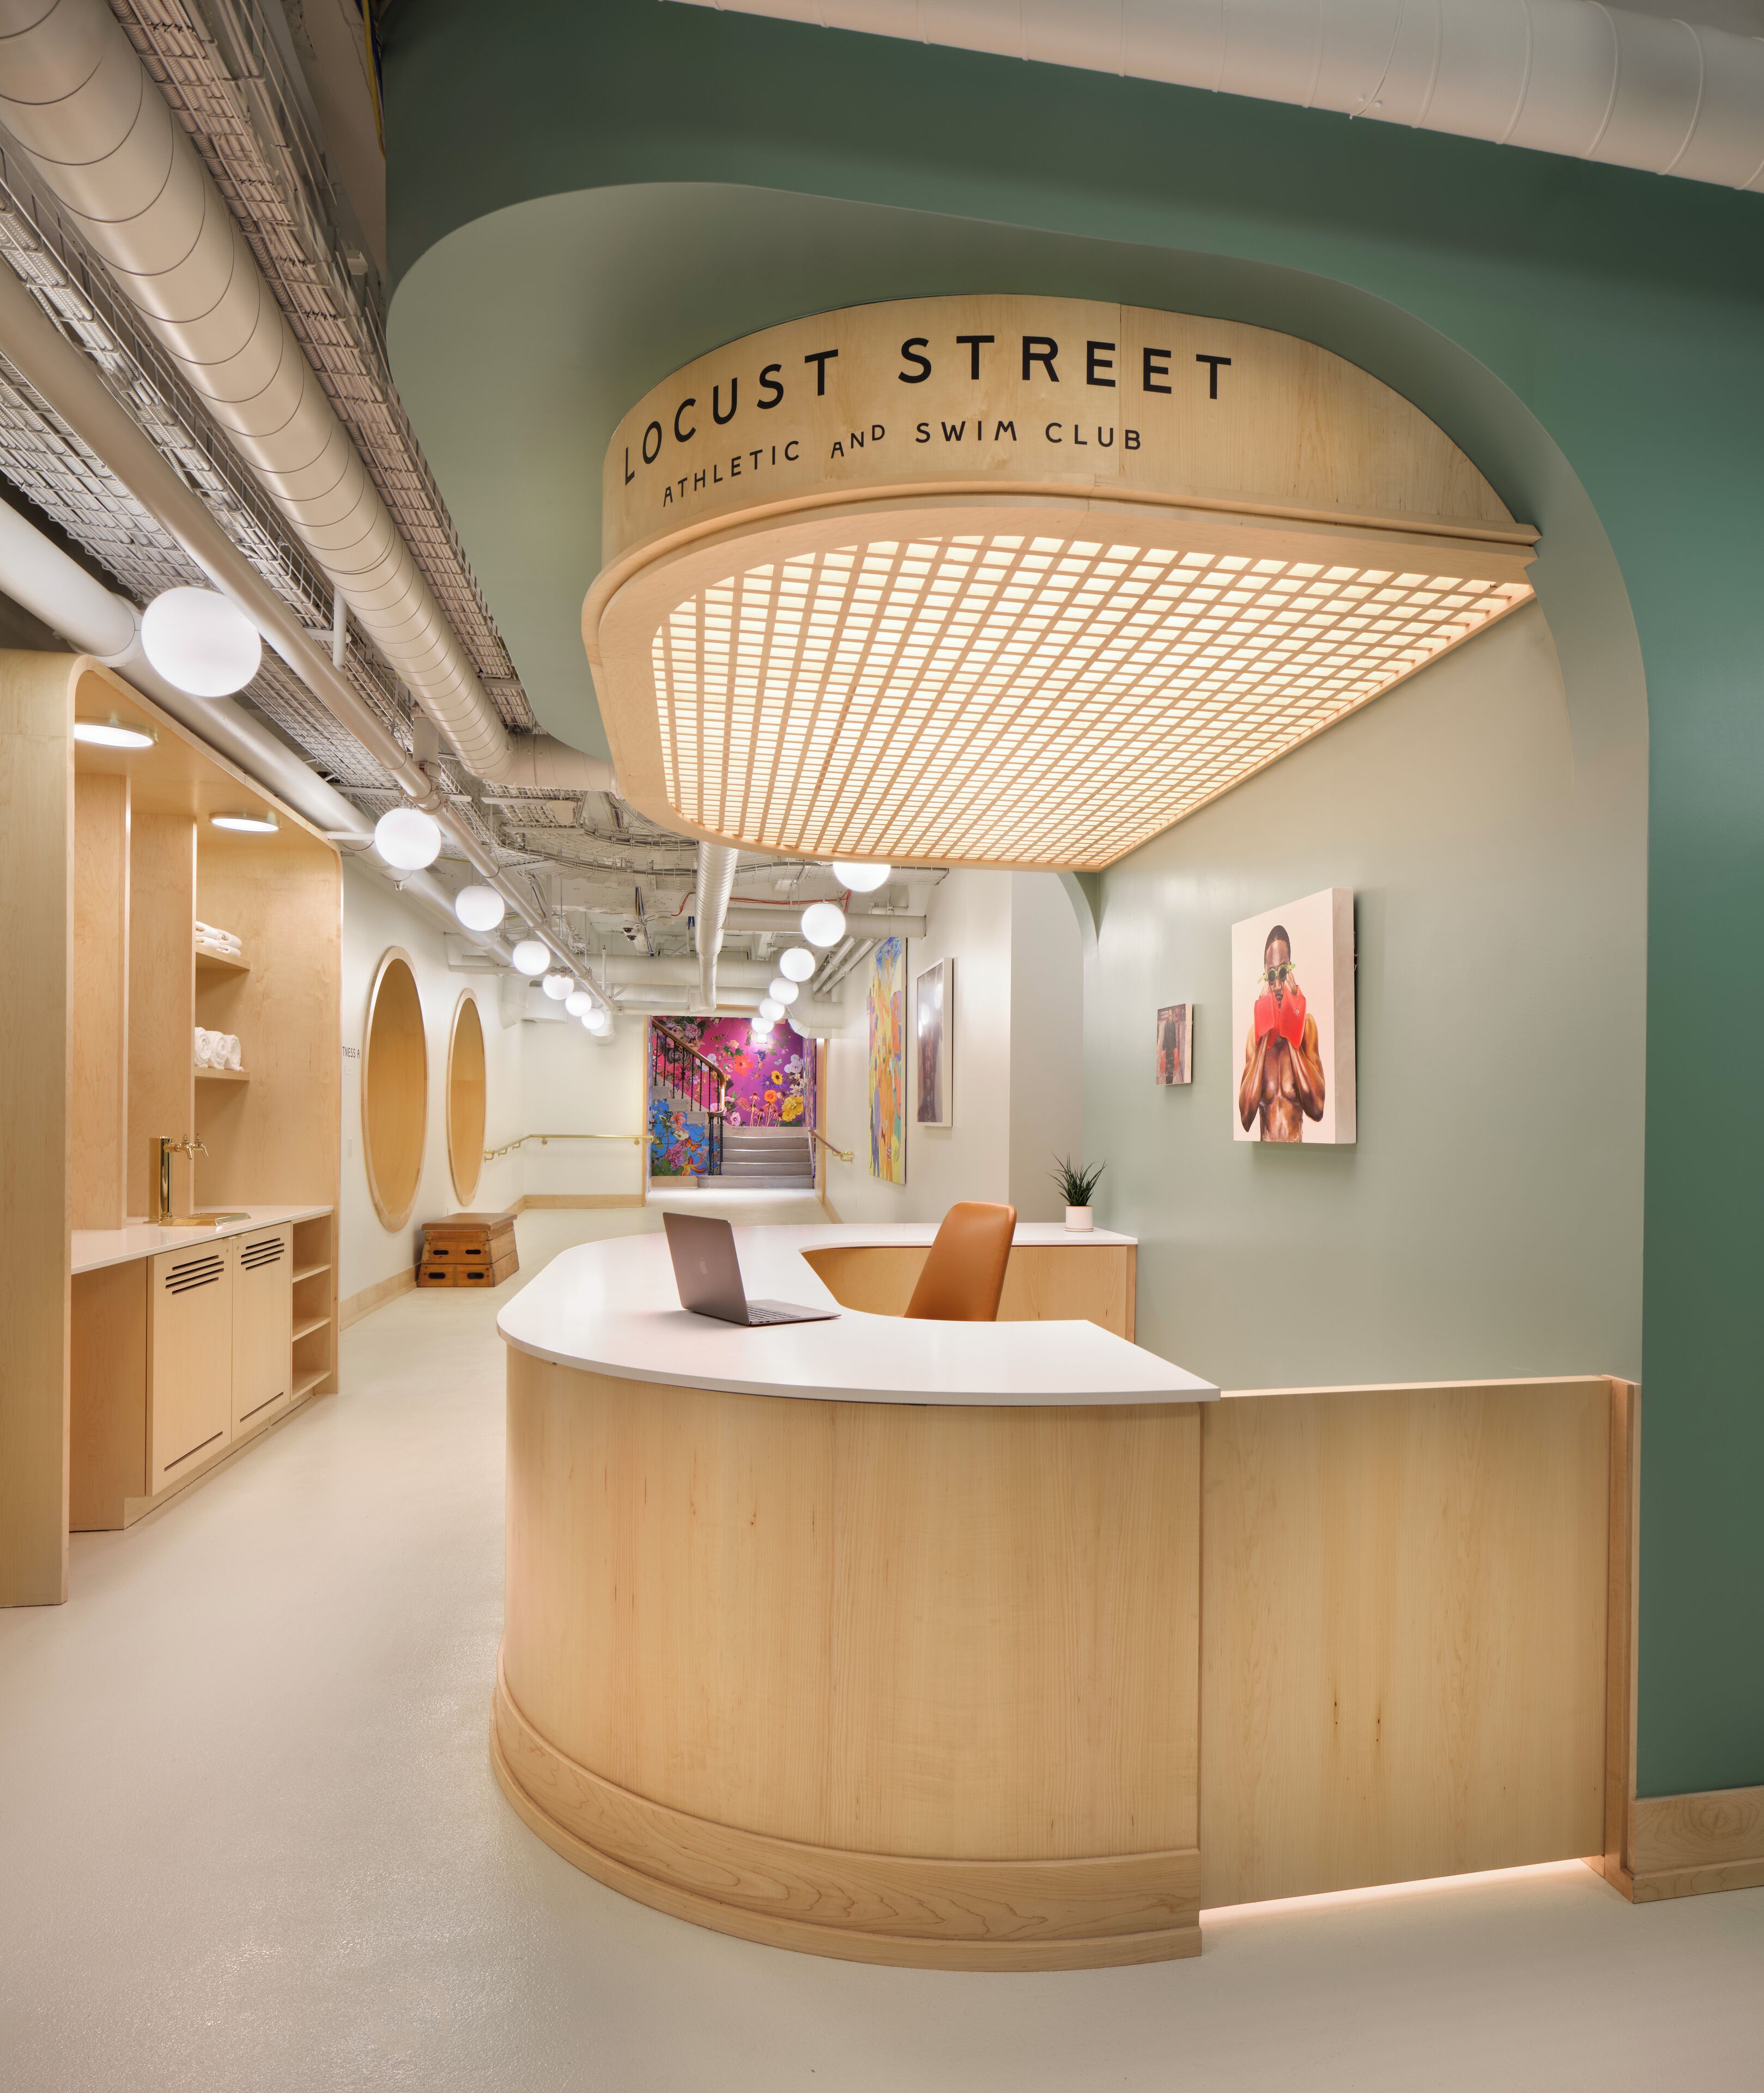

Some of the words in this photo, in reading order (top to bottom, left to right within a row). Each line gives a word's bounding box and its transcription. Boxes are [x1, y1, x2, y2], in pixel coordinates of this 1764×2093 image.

[625, 349, 839, 486] LOCUST
[898, 335, 1232, 400] STREET
[663, 440, 799, 507] ATHLETIC
[831, 424, 886, 459] AND
[916, 421, 1017, 444] SWIM
[1045, 422, 1141, 451] CLUB
